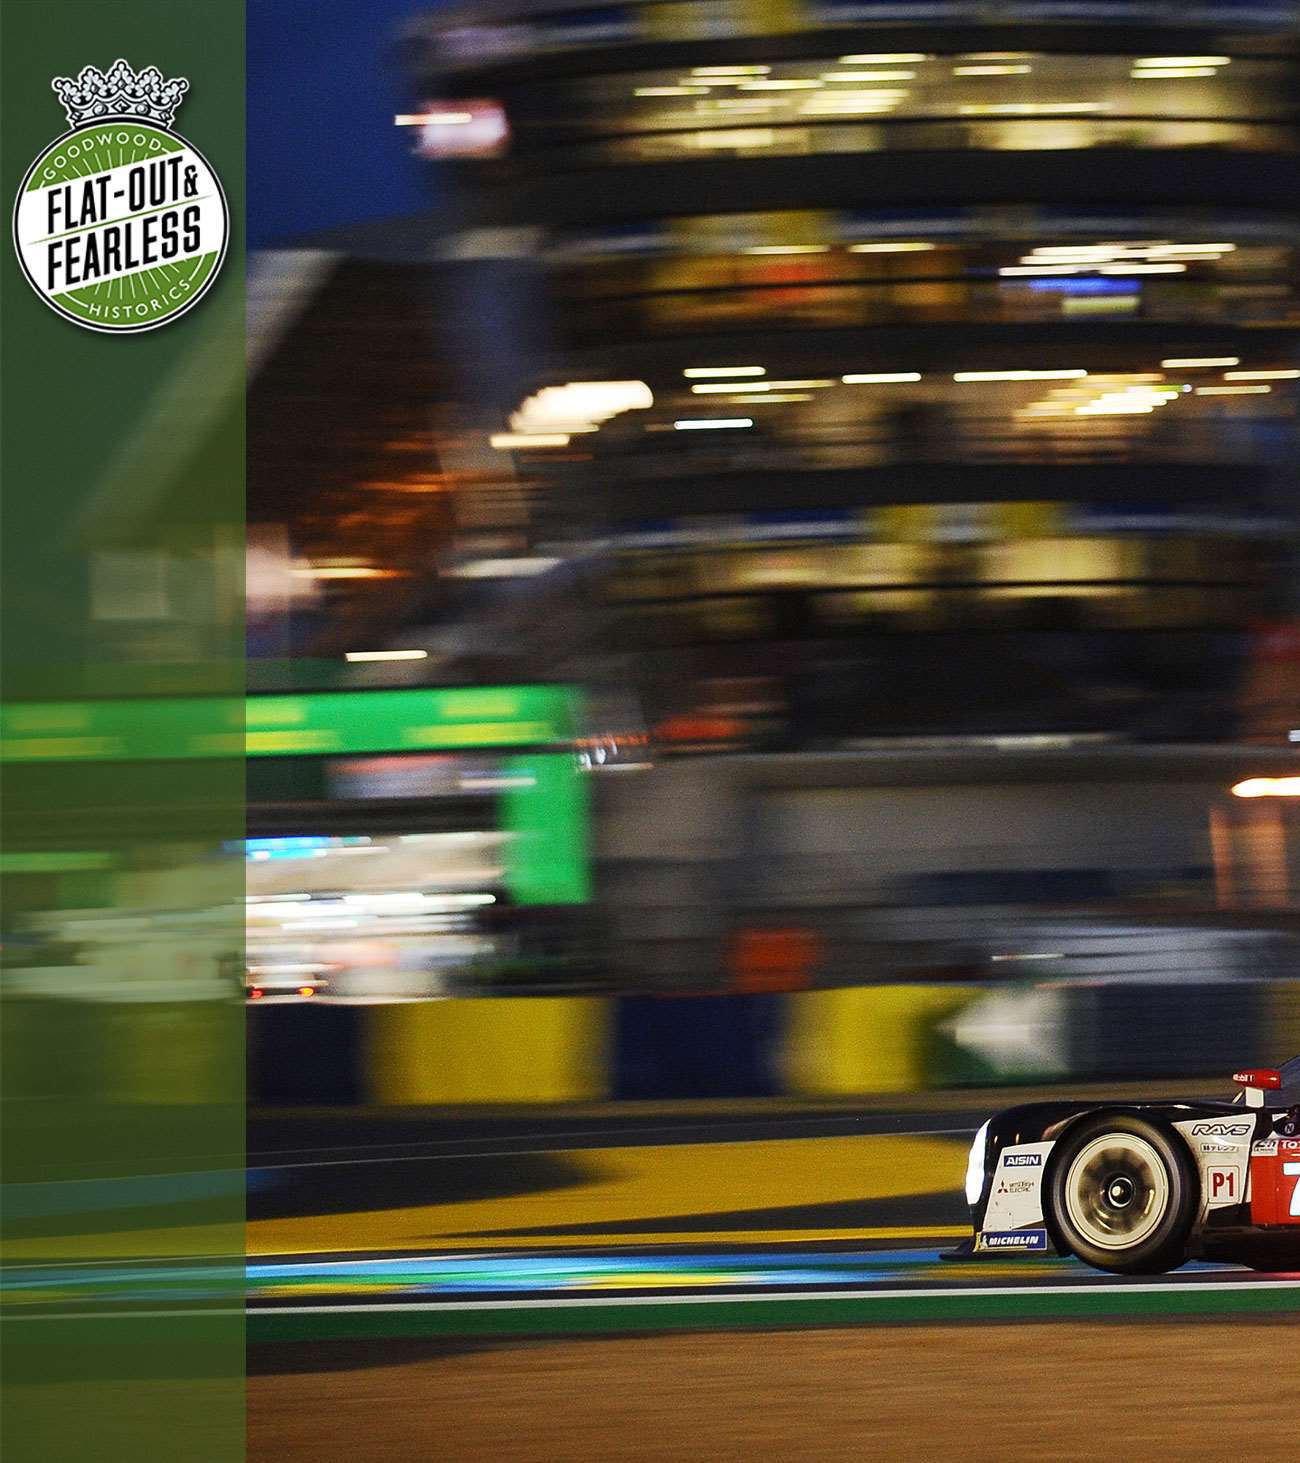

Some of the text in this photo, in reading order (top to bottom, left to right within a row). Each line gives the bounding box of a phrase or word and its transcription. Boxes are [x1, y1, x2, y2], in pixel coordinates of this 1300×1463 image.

[1192, 1123, 1251, 1136] RAYS
[1005, 1155, 1040, 1166] AISIN
[1212, 1172, 1235, 1197] P1
[988, 1235, 1039, 1246] MICHELIN
